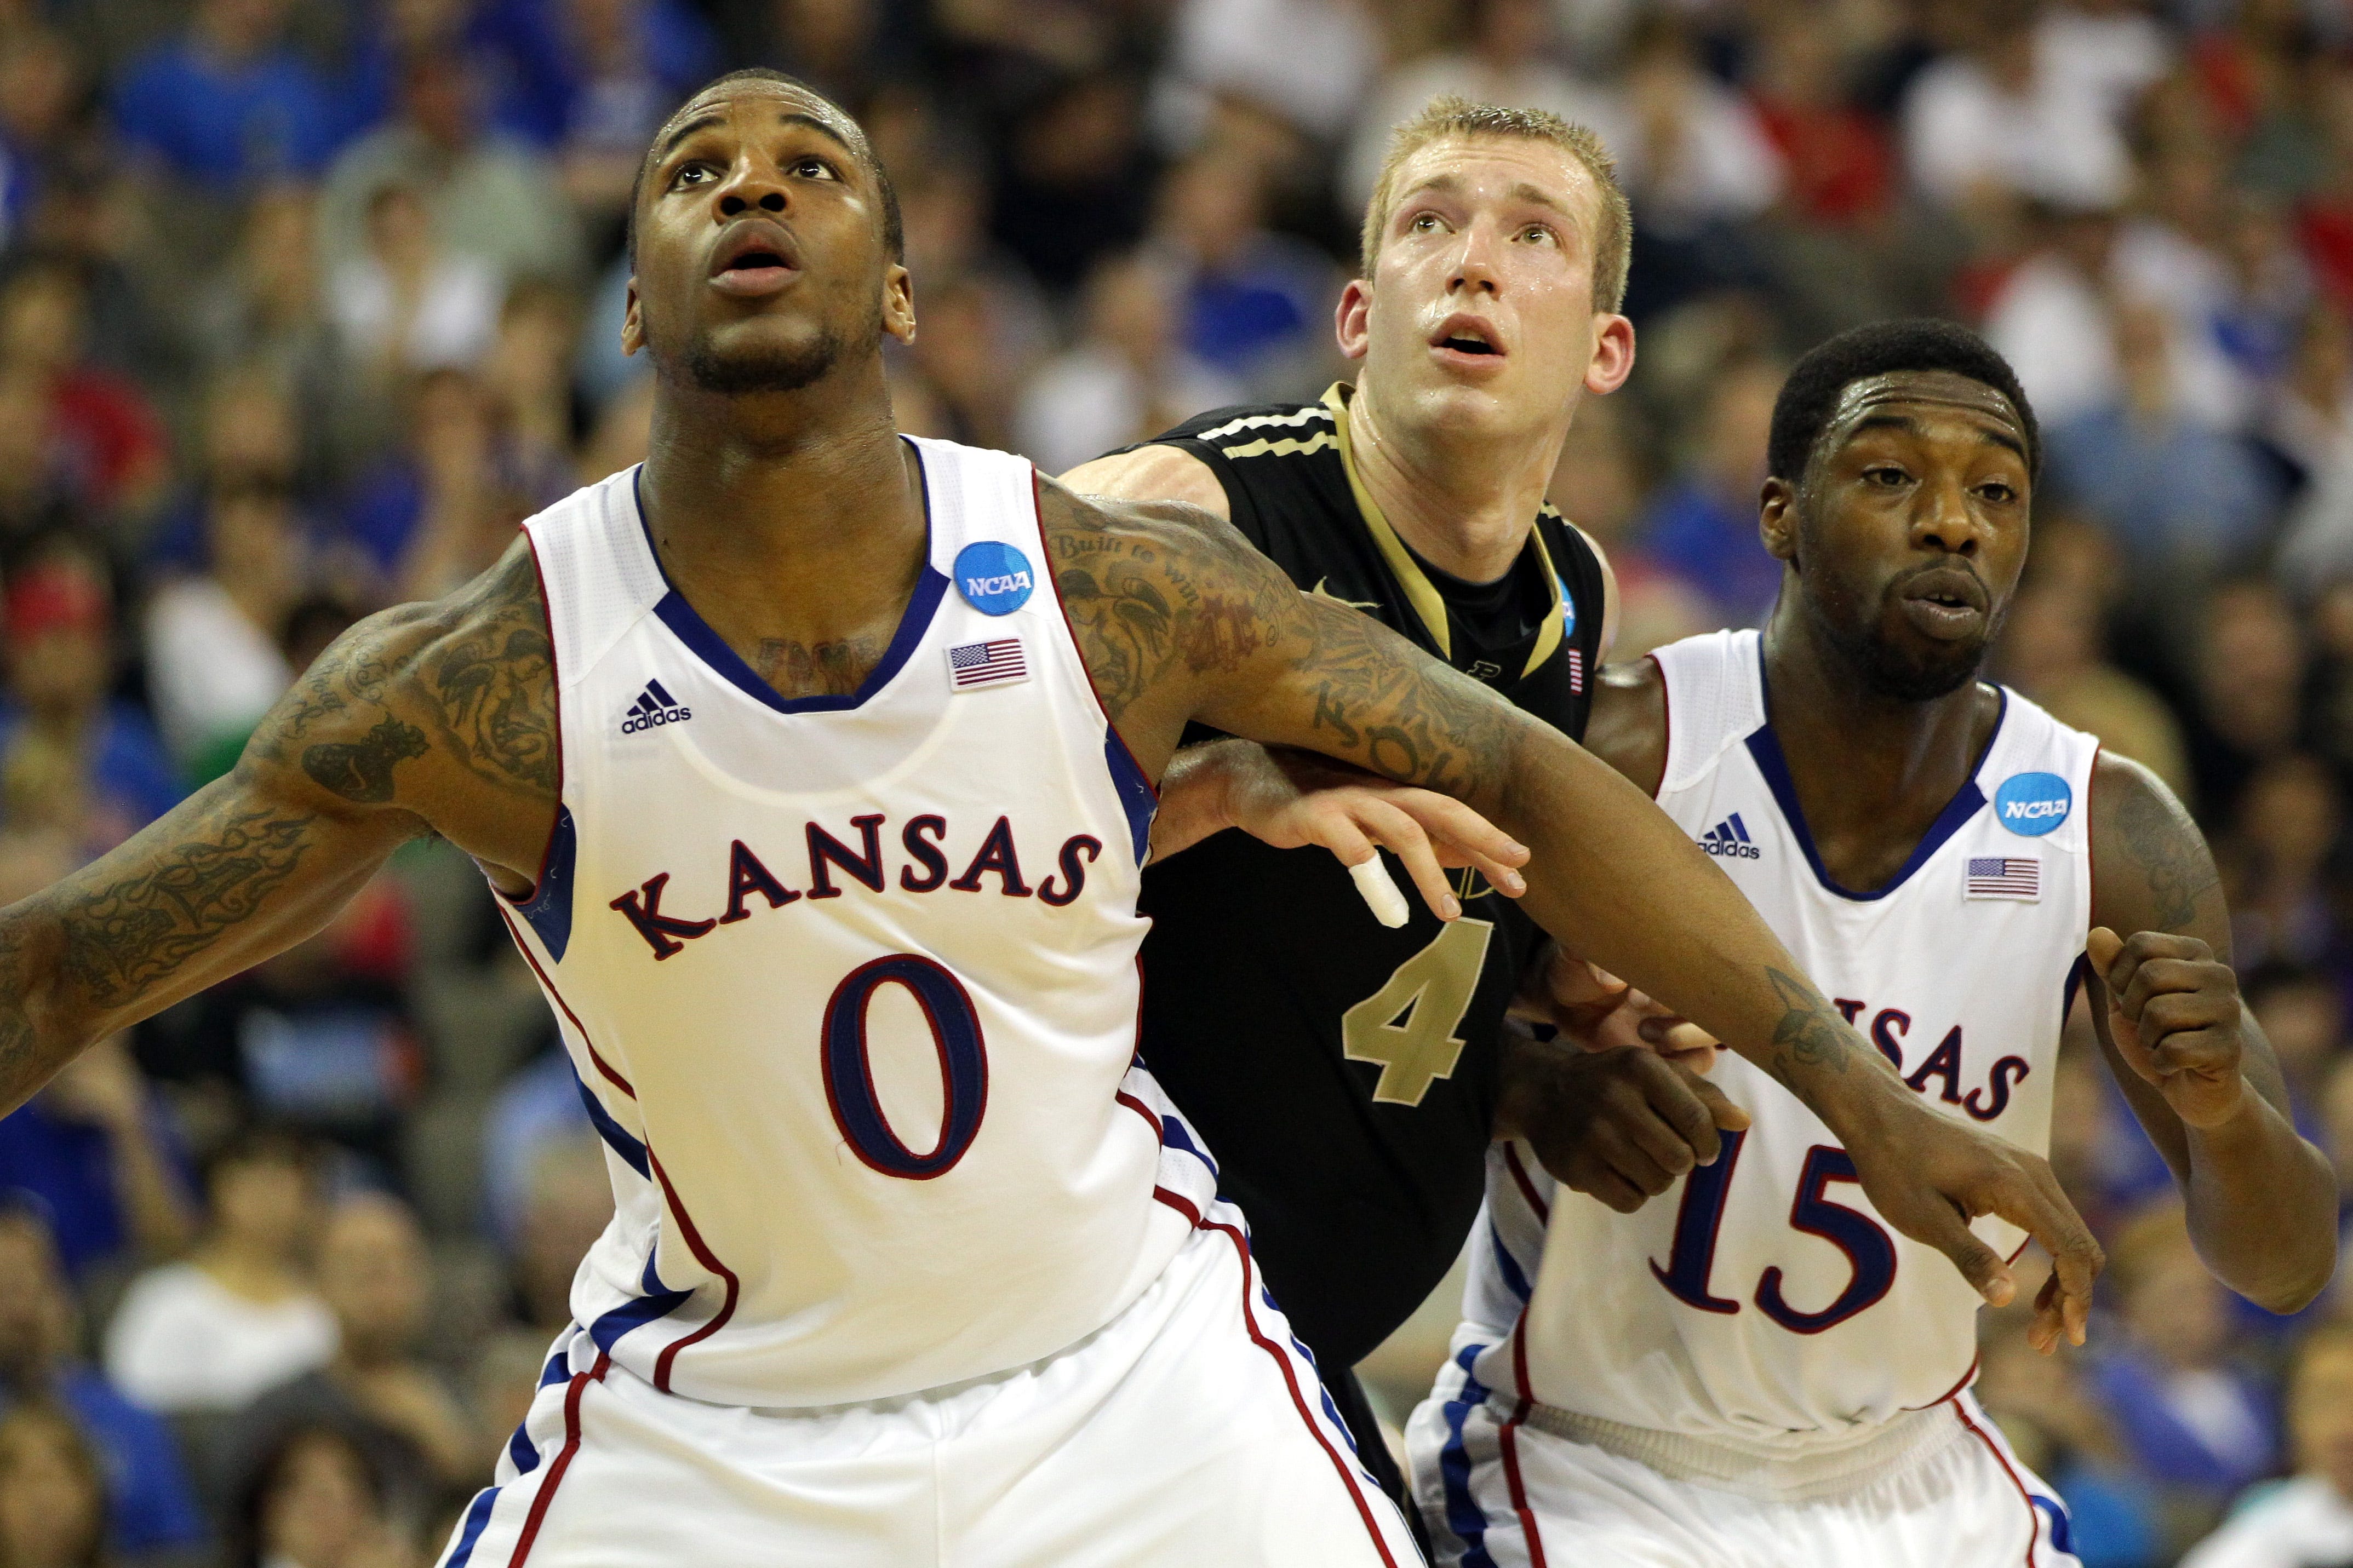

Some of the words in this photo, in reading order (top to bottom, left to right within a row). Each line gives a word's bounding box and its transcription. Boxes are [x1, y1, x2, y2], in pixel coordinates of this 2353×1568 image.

[966, 571, 1032, 596] NCAA
[1058, 535, 1123, 559] Built
[1131, 544, 1156, 564] to
[622, 707, 691, 734] adidas
[2005, 799, 2068, 819] NCAA
[609, 813, 1102, 961] KANSAS
[820, 953, 988, 1181] 0
[1342, 917, 1495, 1107] 4
[1833, 998, 2030, 1122] SAS
[1648, 1126, 1897, 1335] 15
